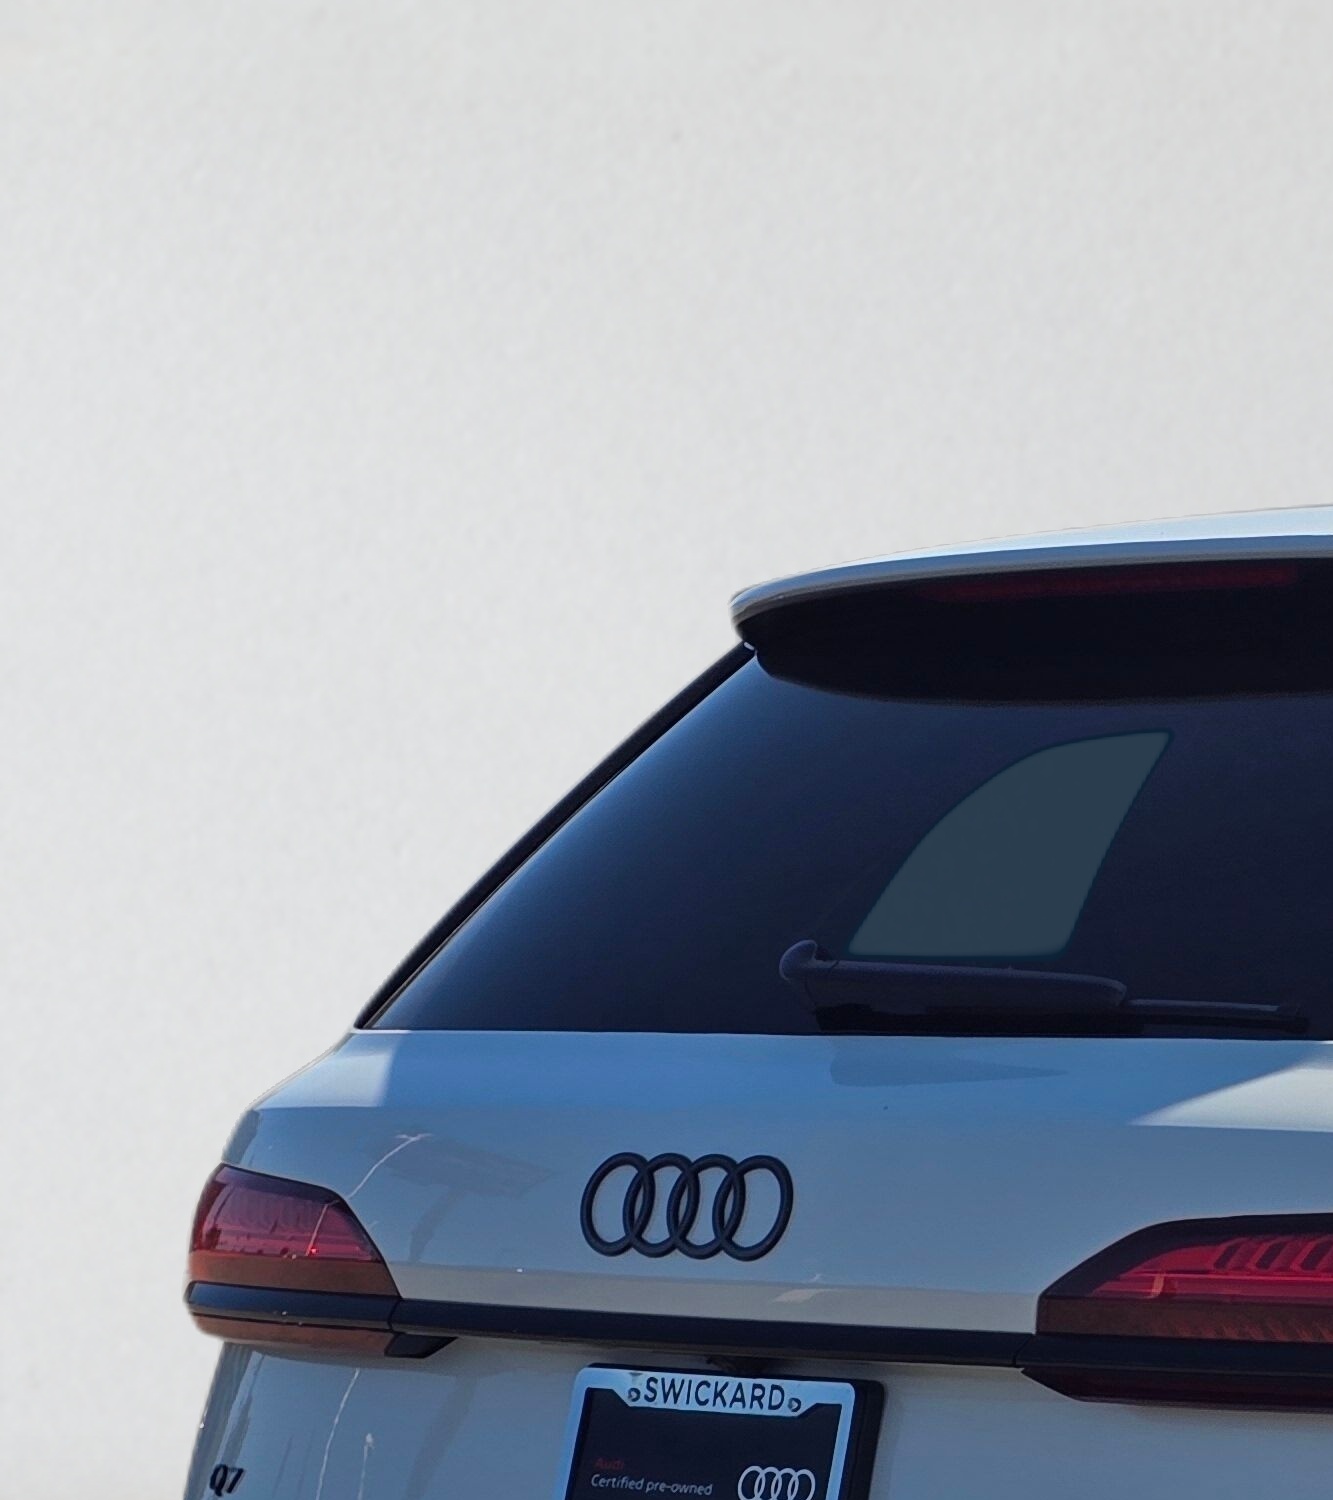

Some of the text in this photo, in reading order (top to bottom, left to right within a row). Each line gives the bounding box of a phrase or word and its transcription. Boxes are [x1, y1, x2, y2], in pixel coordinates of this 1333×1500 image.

[643, 1376, 786, 1412] SWICKARD
[209, 1463, 245, 1497] Q7
[590, 1473, 713, 1496] Certified pre-owned
